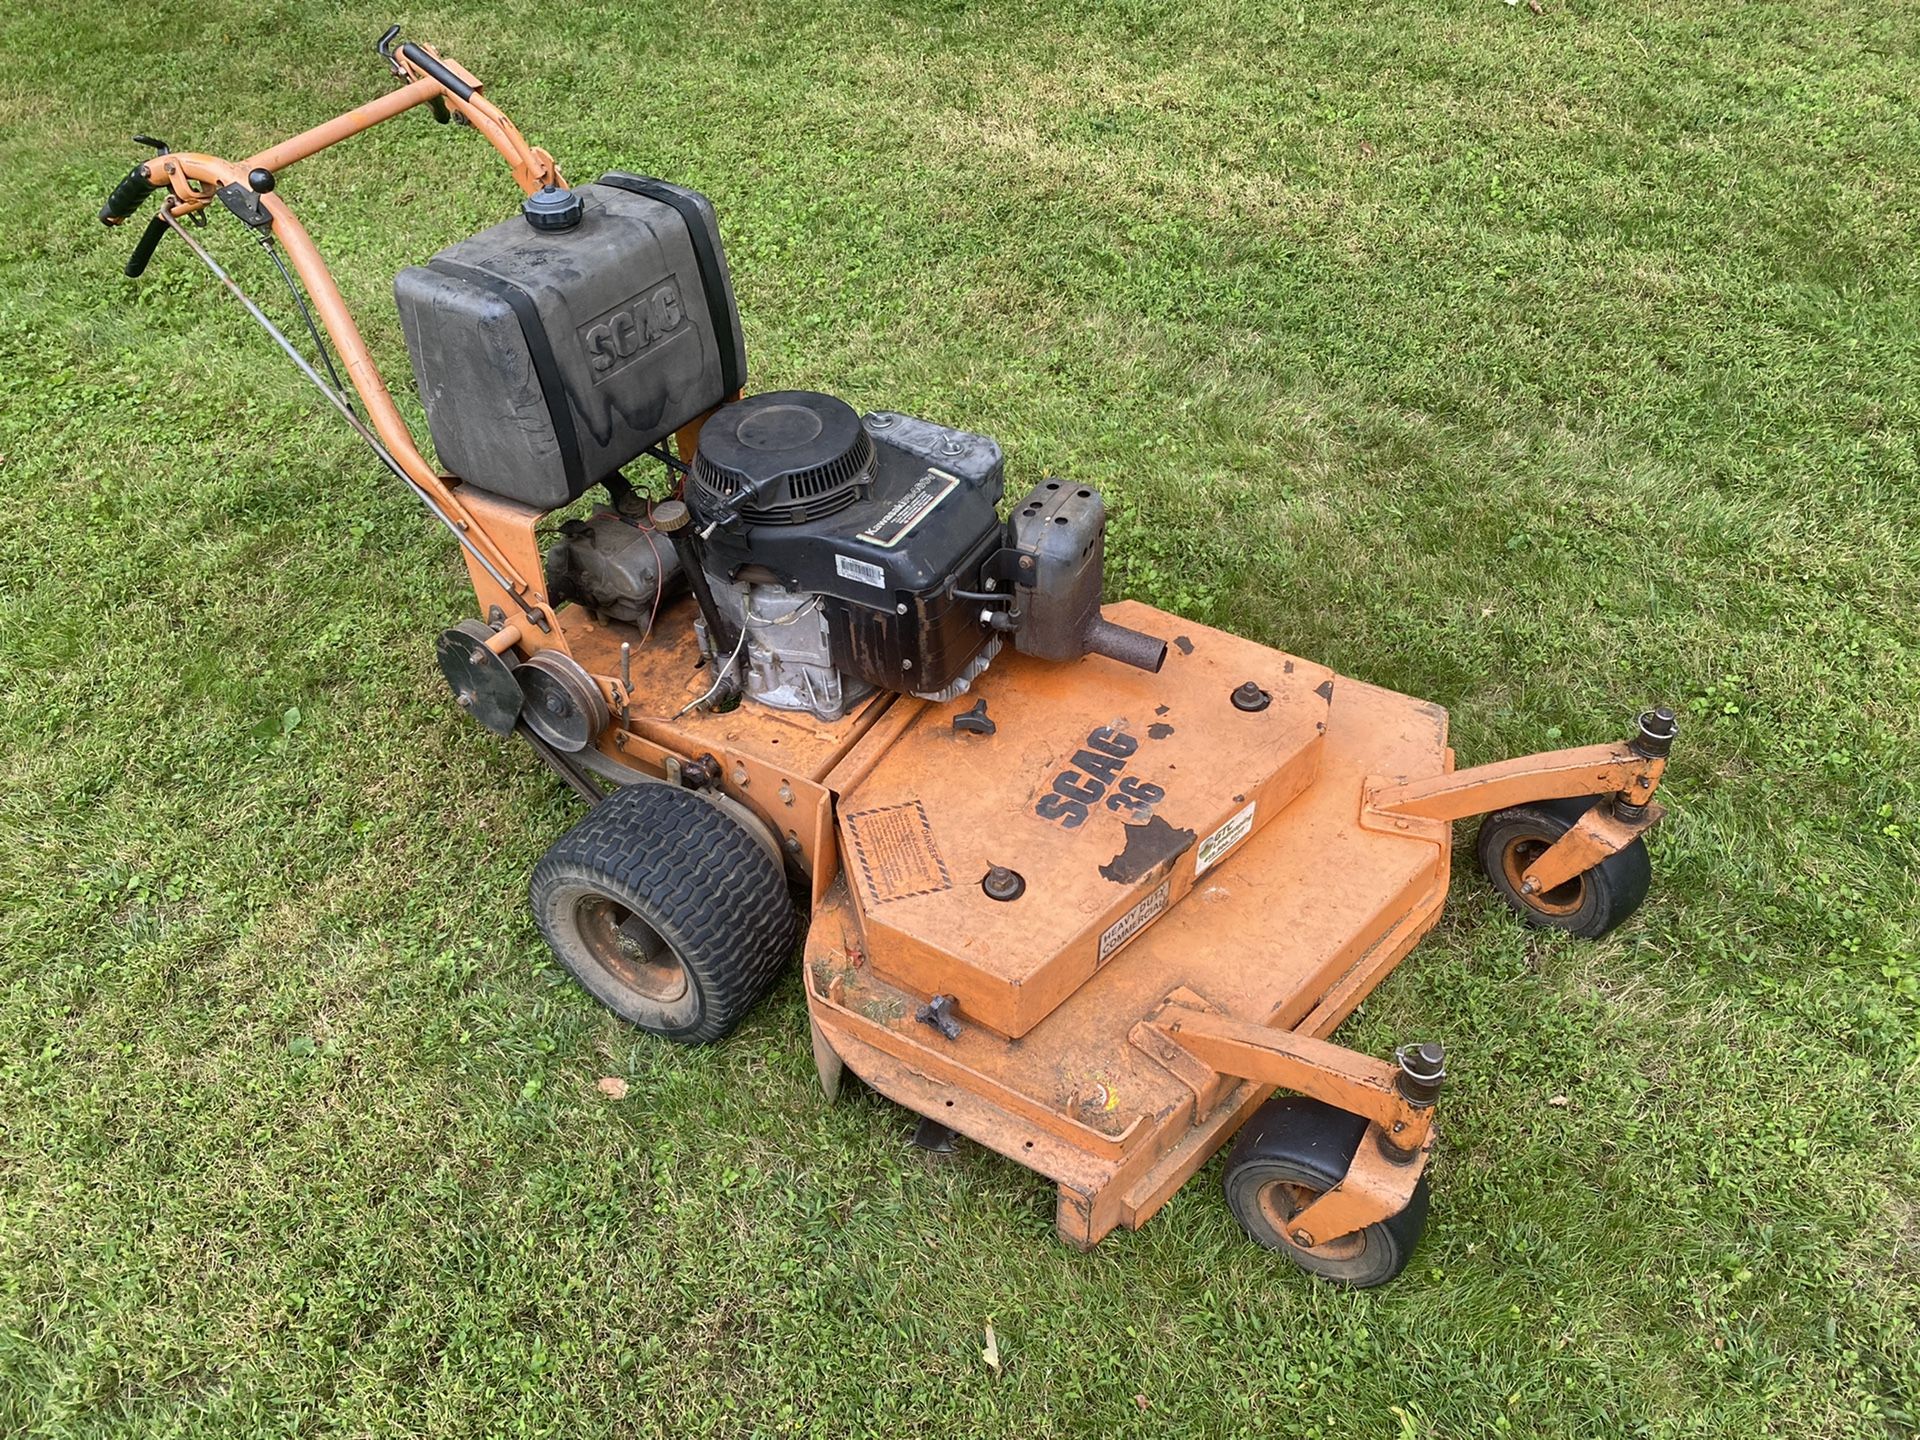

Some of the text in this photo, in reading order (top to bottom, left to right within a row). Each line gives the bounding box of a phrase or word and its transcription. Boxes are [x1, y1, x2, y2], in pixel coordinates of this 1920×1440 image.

[586, 286, 680, 371] SCAG
[1035, 726, 1138, 828] SCAG
[1106, 776, 1165, 822] 36
[921, 829, 938, 860] DANGER
[1104, 885, 1165, 943] HEAVY DUTY
